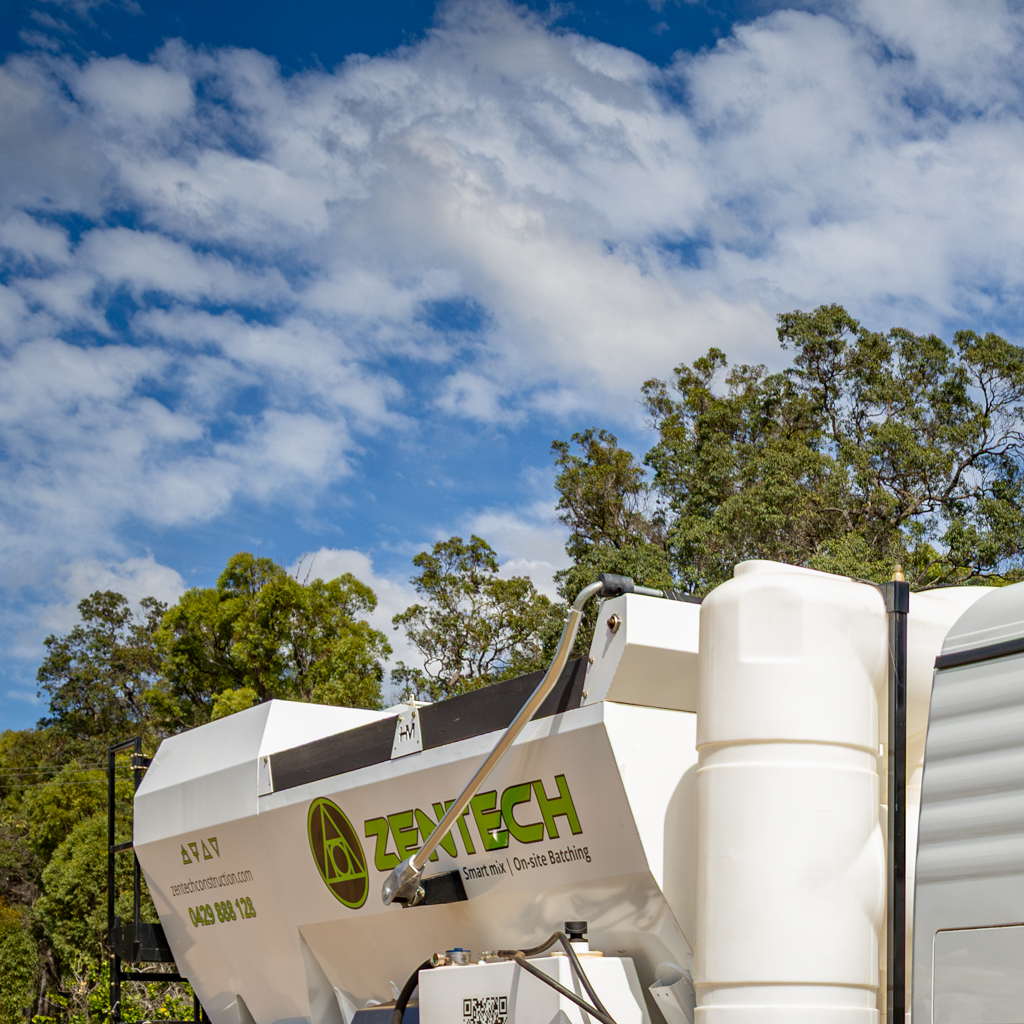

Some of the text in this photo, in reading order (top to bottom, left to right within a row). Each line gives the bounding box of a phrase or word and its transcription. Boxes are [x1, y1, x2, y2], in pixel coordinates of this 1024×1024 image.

[364, 773, 583, 872] ZENTECH
[462, 863, 489, 880] Smart
[489, 860, 507, 877] mix
[513, 851, 548, 871] On-site
[549, 846, 592, 867] Batching
[170, 870, 254, 896] zentechconstruction.com
[188, 896, 257, 928] 0429 888 128
